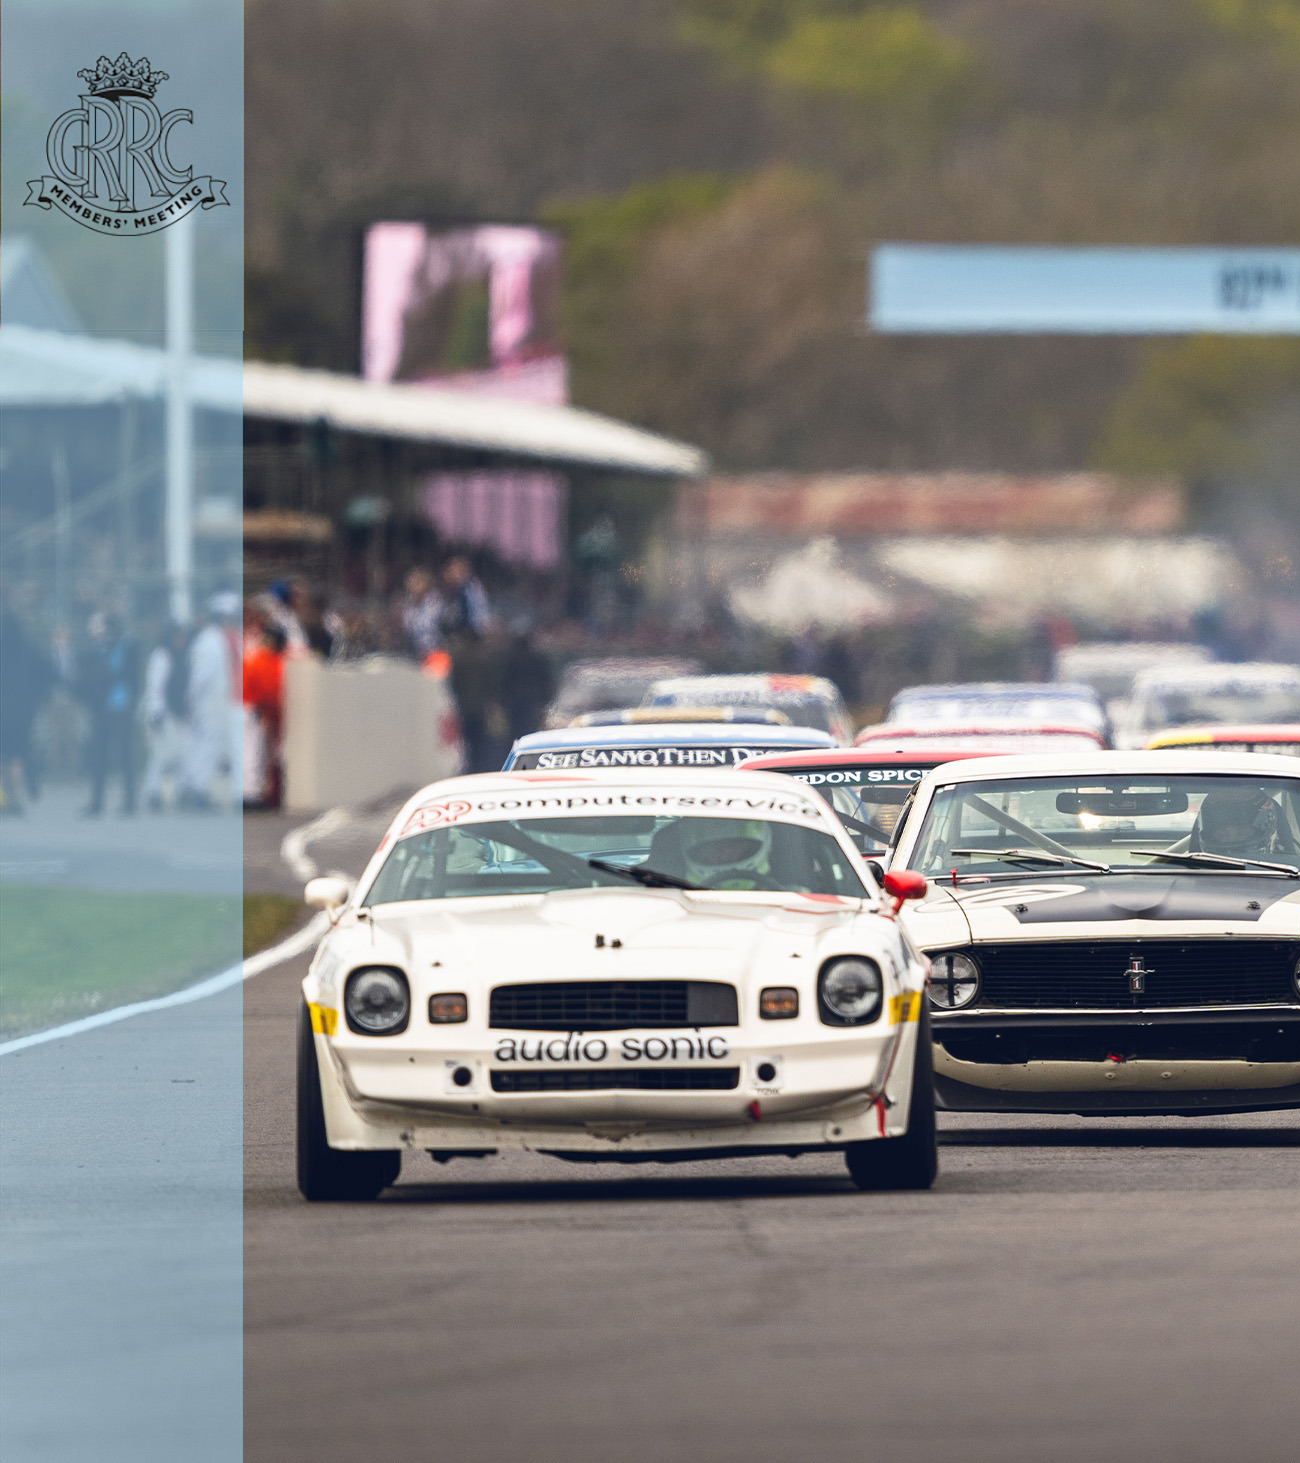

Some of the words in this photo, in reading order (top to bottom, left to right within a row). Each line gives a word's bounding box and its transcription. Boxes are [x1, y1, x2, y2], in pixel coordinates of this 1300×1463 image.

[535, 753, 578, 769] SEE
[495, 1029, 607, 1062] audio
[621, 1027, 730, 1061] sonic
